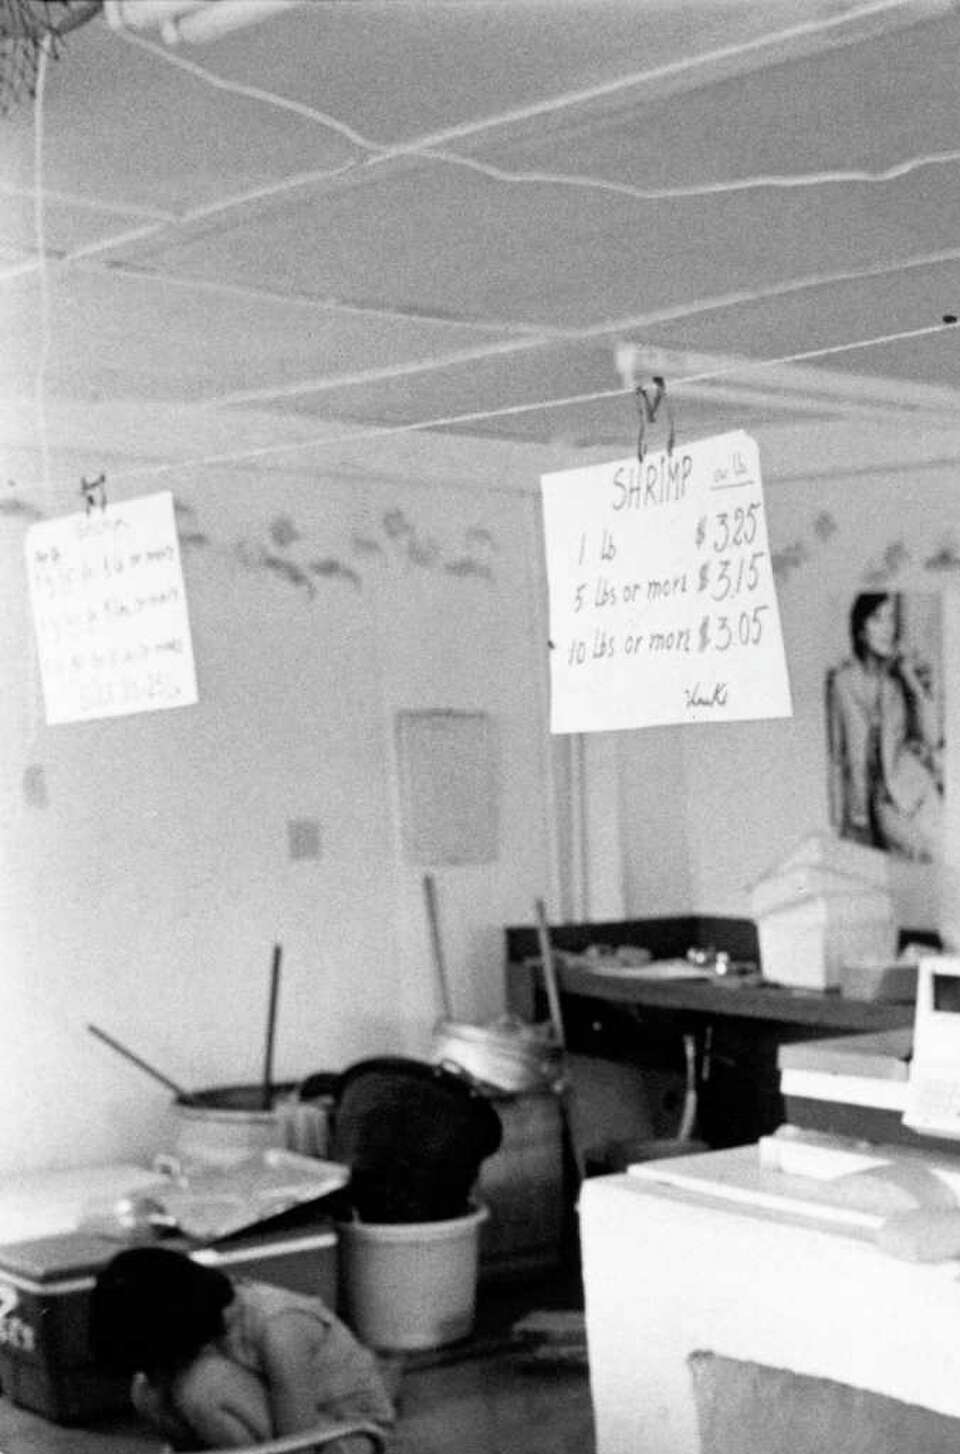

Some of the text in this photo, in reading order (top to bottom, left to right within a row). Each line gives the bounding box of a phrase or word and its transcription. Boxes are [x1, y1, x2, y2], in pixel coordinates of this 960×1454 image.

[612, 454, 693, 511] SHRIMP
[578, 532, 587, 567] 1
[574, 582, 588, 614] 5
[623, 583, 642, 604] or
[568, 638, 587, 667] 10
[624, 635, 644, 656] or
